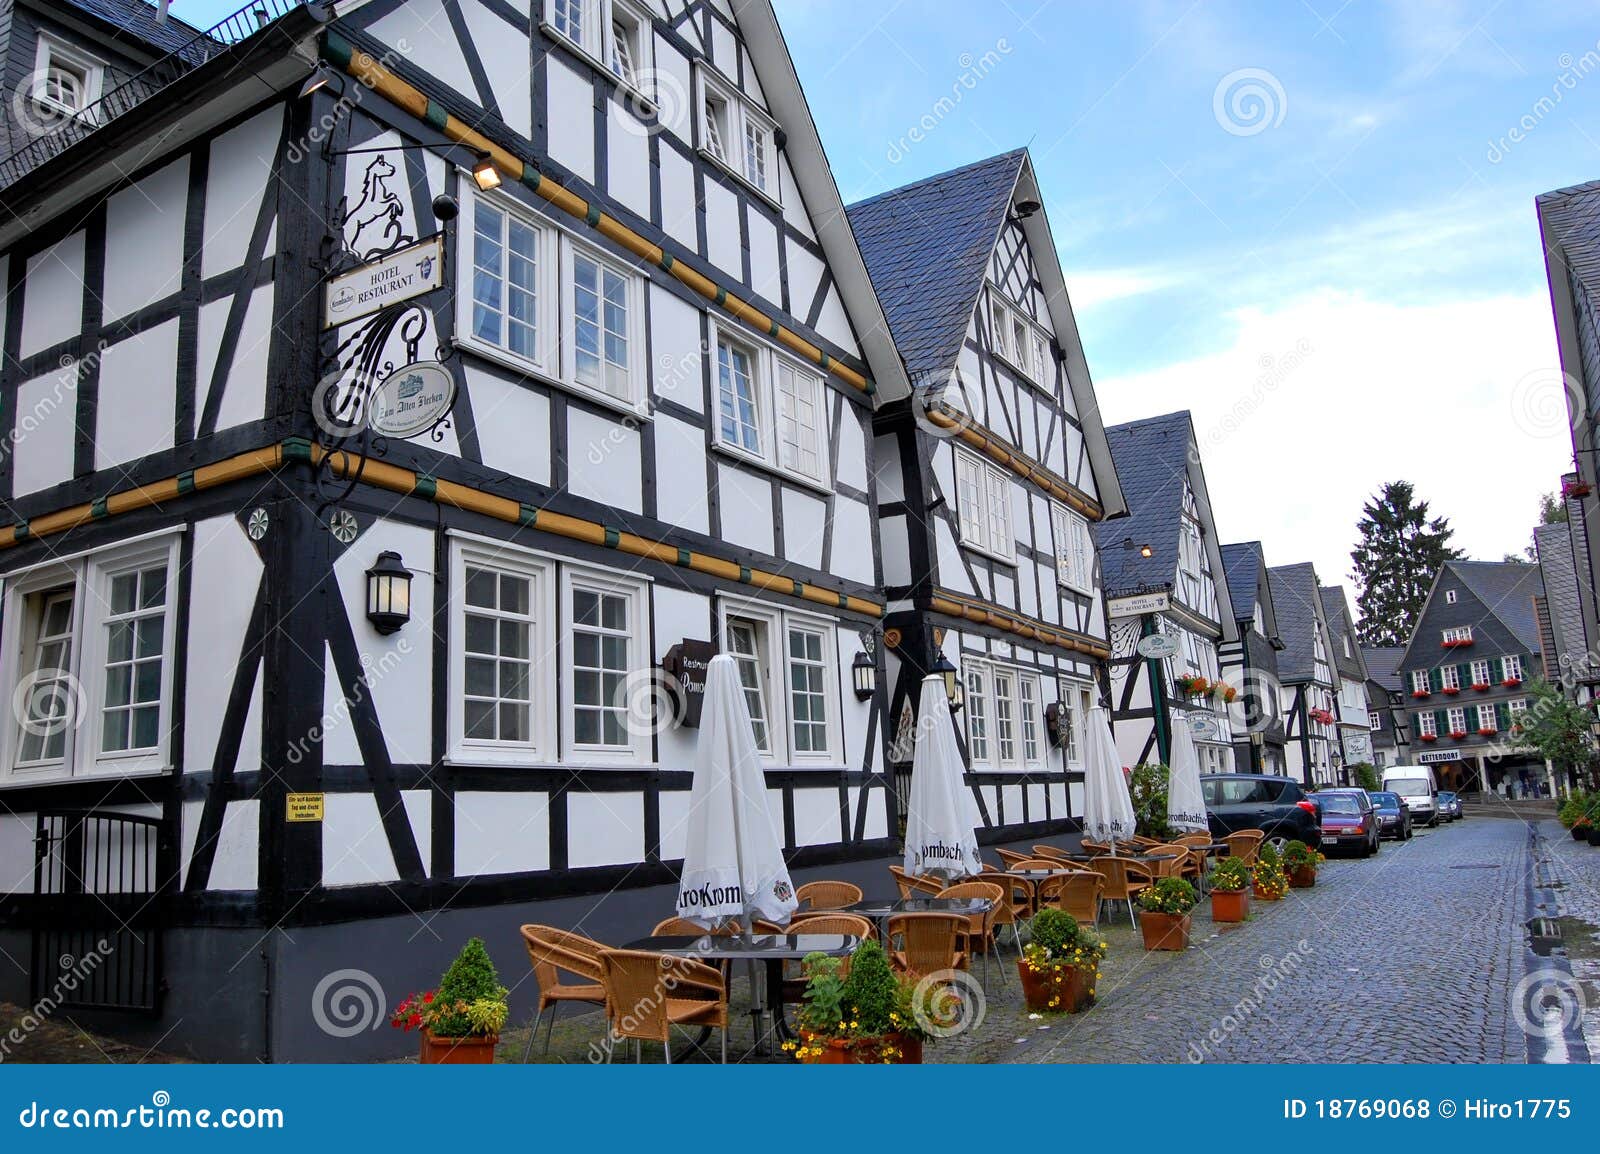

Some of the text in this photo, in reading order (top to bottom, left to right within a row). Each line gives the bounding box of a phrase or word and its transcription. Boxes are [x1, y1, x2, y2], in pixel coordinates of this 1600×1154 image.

[371, 266, 400, 285] HOTEL
[358, 274, 414, 304] RESTAURANT
[397, 400, 416, 413] Alten
[683, 656, 708, 670] Restaur
[1421, 752, 1458, 761] BETTENDORF
